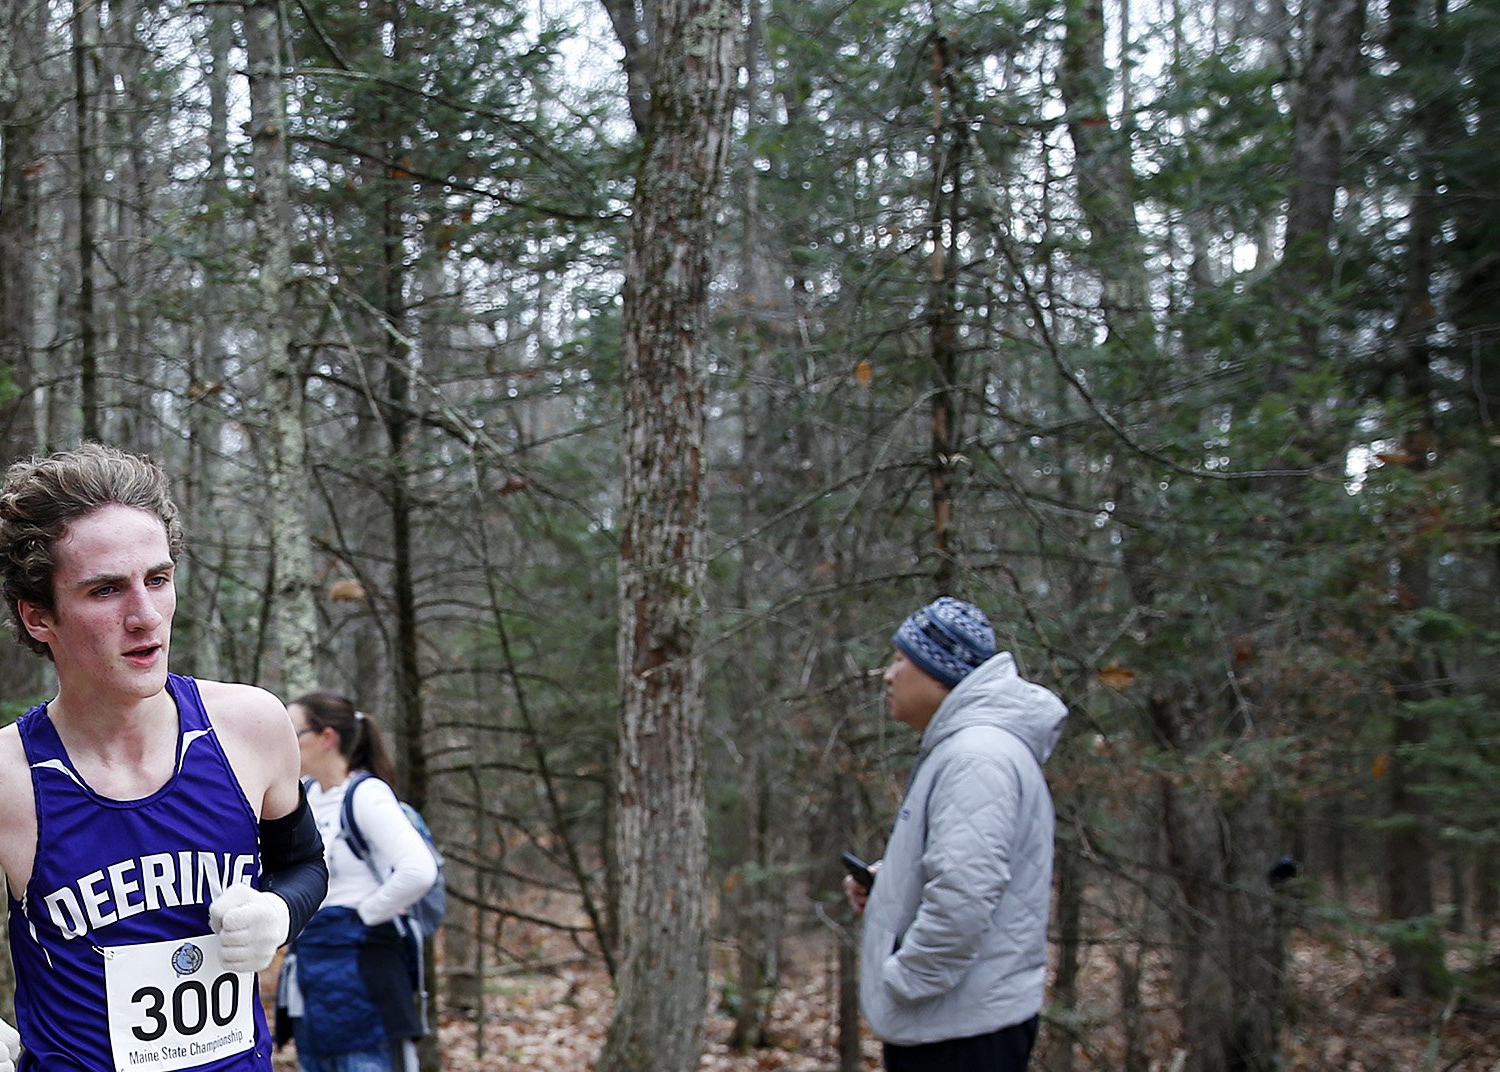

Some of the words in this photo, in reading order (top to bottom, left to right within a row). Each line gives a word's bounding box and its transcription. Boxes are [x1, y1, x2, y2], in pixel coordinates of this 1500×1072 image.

[44, 851, 254, 940] DEERING
[131, 972, 239, 1041] 300
[129, 1049, 159, 1065] Maine
[161, 1045, 187, 1060] State
[190, 1029, 243, 1056] Championship
